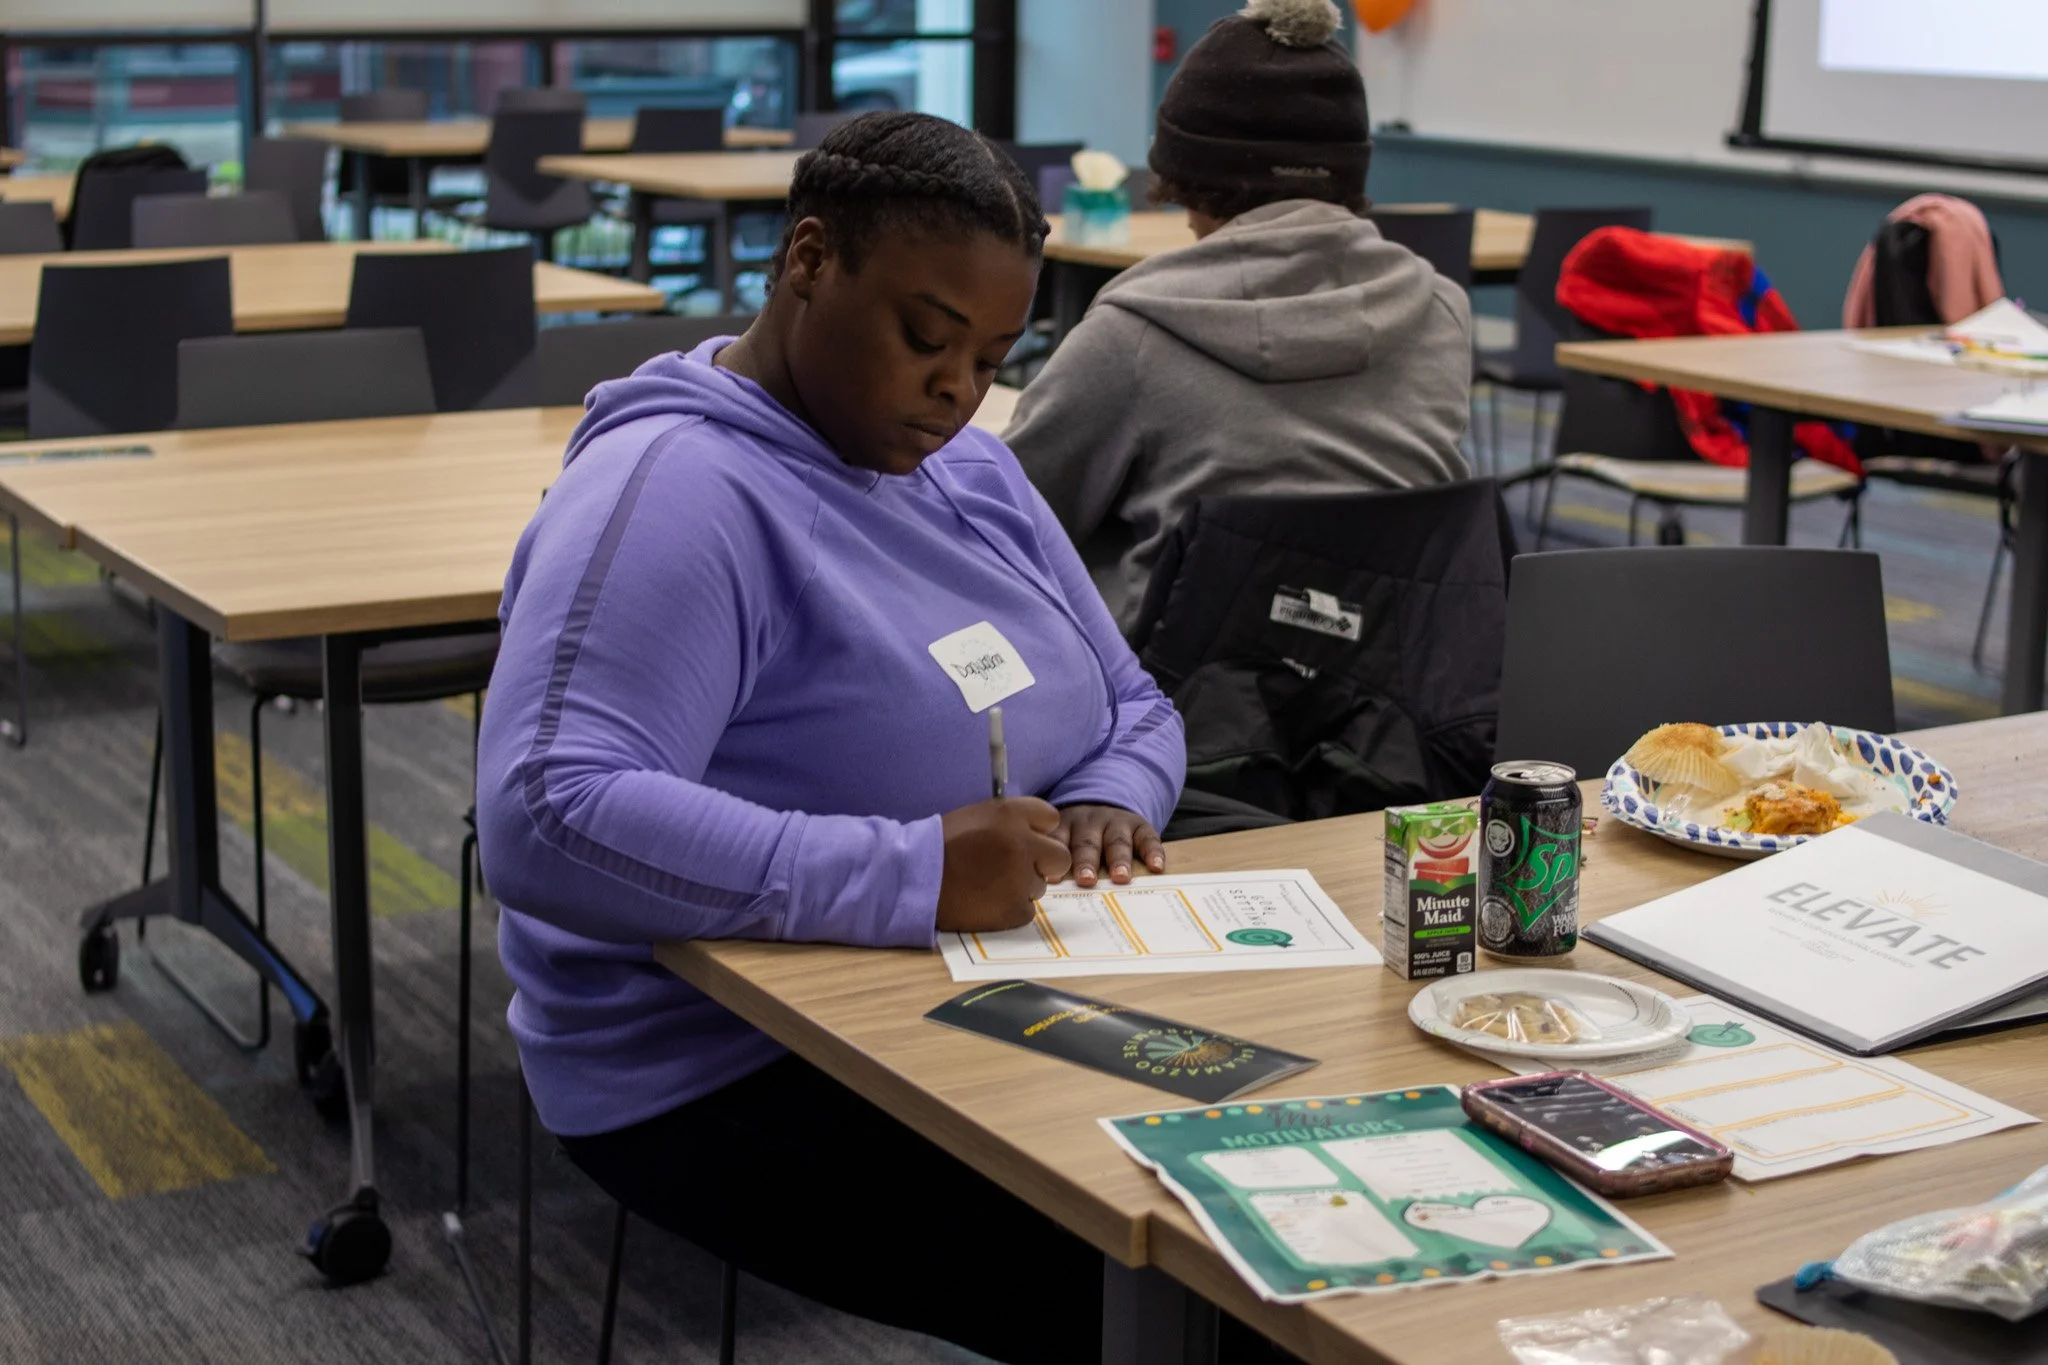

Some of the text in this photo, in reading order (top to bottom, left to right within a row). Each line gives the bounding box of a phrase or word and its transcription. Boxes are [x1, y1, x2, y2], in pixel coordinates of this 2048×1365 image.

[1416, 895, 1470, 912] Minute
[1423, 908, 1462, 925] Maid
[1765, 882, 1987, 970] ELEVATE
[1220, 1118, 1404, 1148] MOTIVATORS
